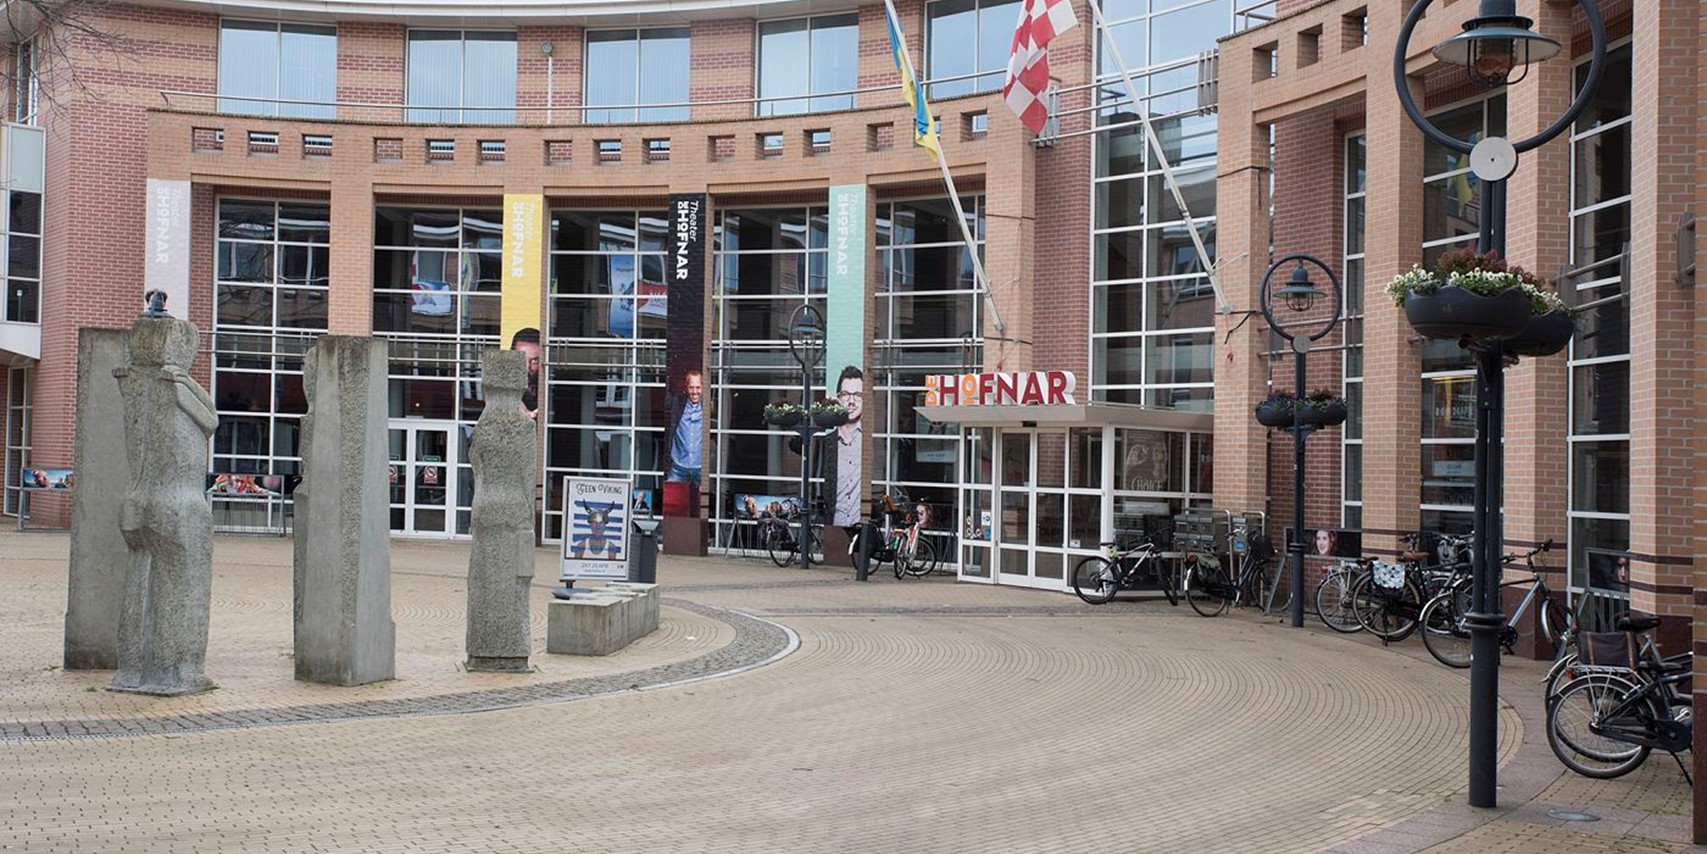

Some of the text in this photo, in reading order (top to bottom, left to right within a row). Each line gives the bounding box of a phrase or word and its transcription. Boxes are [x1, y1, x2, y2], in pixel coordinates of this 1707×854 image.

[156, 195, 170, 263] HOFNAR
[512, 210, 525, 278] HOFNAR
[676, 201, 690, 280] DE HOFNAR
[690, 200, 699, 242] Theater
[837, 202, 849, 276] HOFNAR
[925, 370, 1070, 406] DE HOFNAR
[598, 482, 622, 494] VIKING
